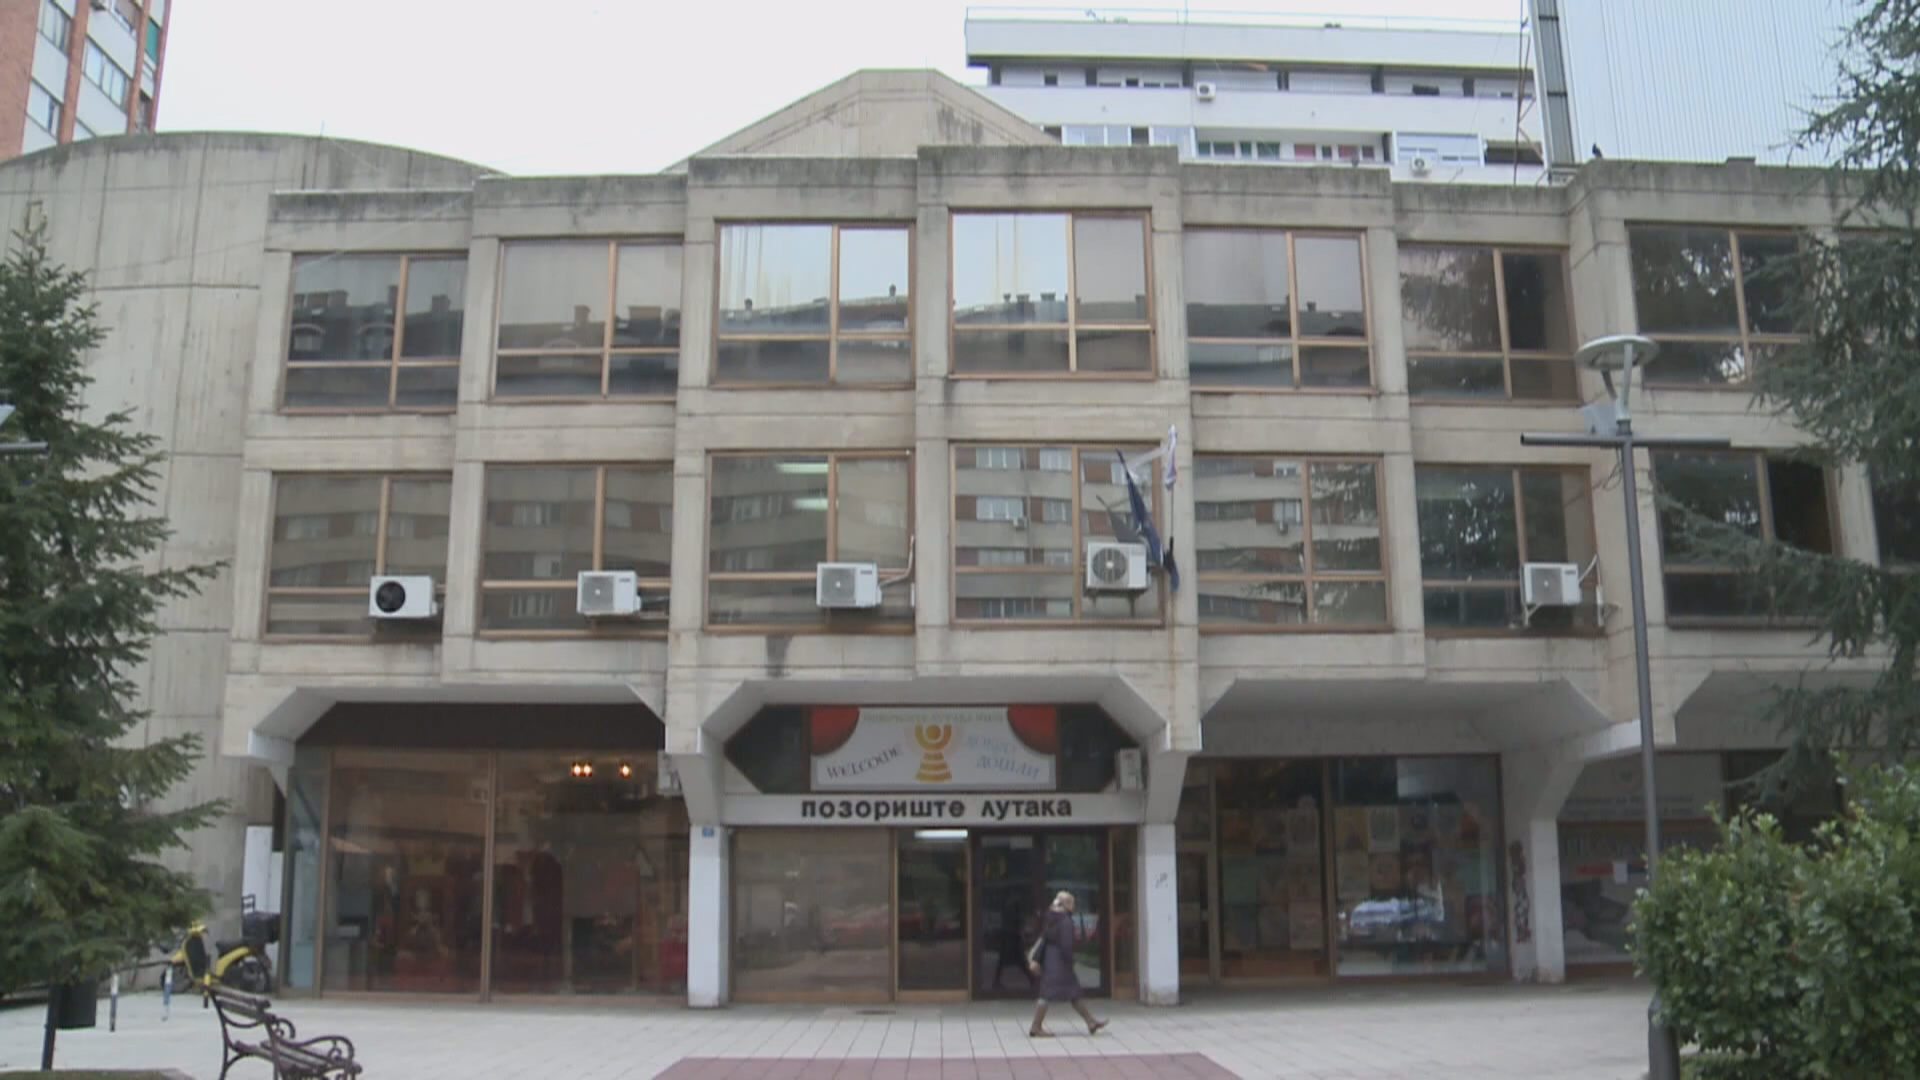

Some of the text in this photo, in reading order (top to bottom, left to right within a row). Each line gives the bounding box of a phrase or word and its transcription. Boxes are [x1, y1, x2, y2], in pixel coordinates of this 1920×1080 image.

[827, 744, 904, 779] WELCOME
[801, 799, 1073, 821] позориште лутака
